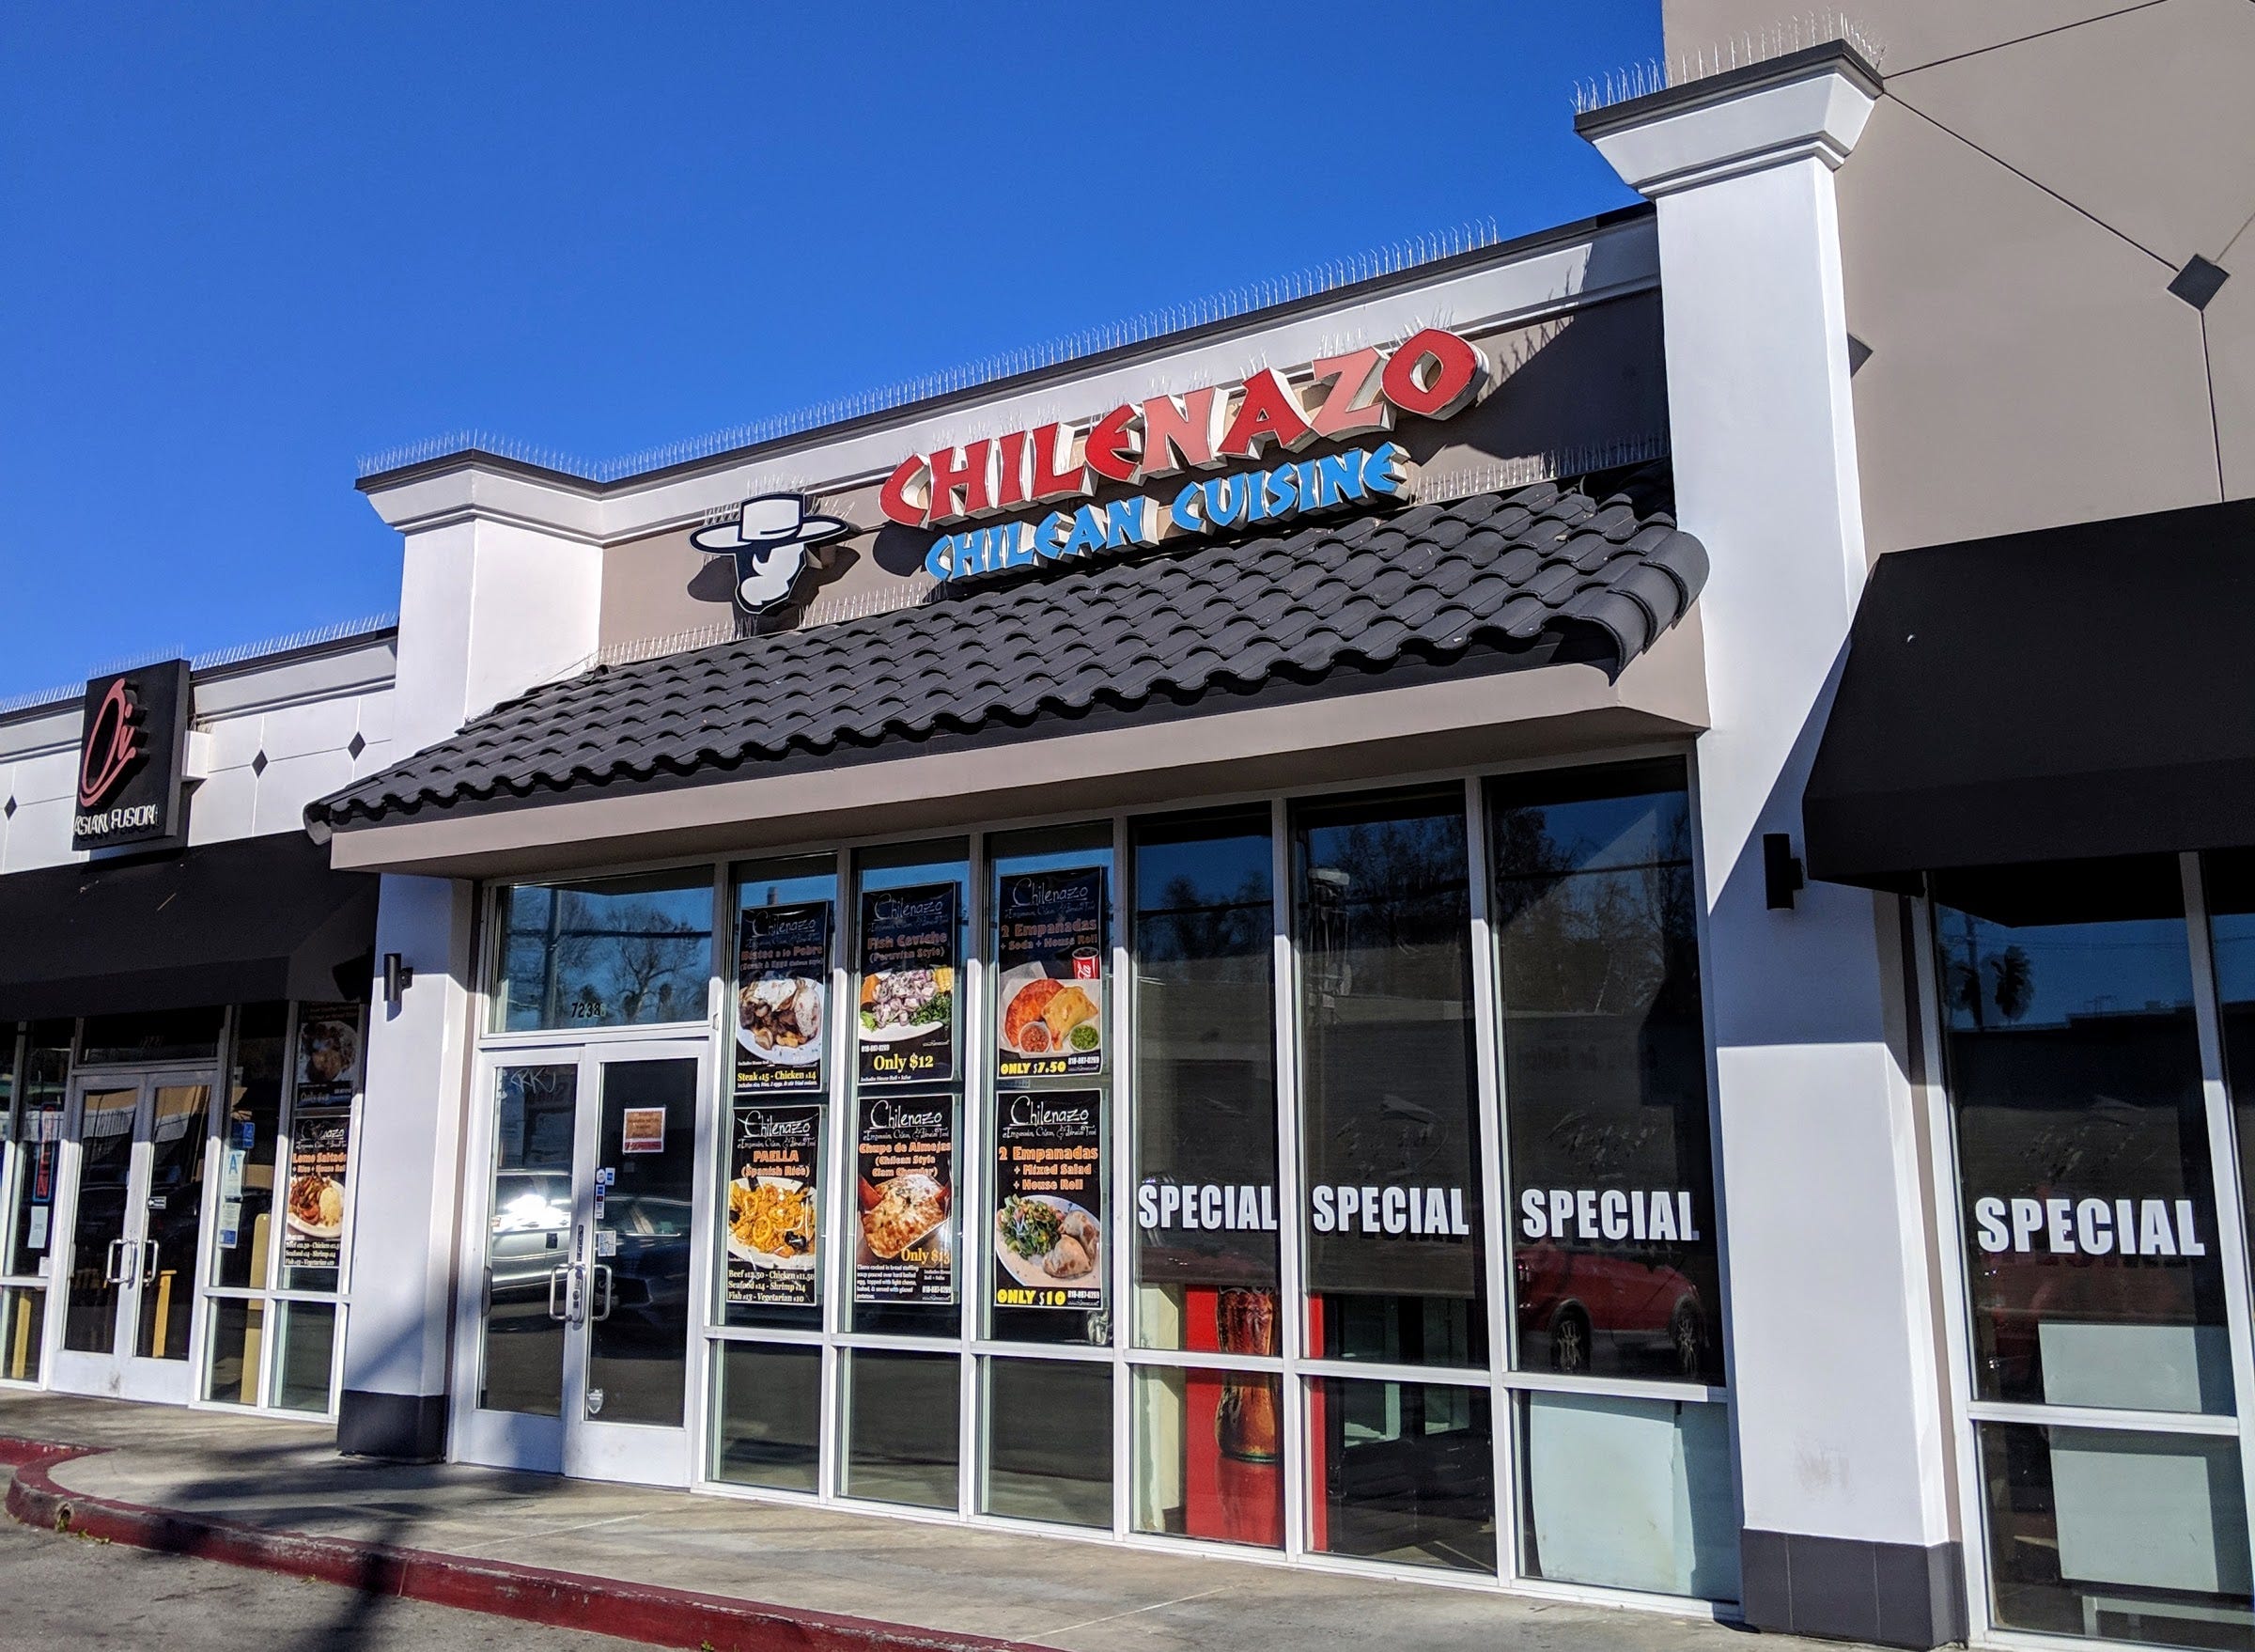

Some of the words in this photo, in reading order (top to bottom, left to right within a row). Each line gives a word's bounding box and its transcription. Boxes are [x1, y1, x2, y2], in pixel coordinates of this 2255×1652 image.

[879, 328, 1486, 528] CHILENAZO
[925, 494, 1152, 582] CHILEAN
[1172, 442, 1411, 535] CUISINE
[74, 813, 109, 835] ASIAN
[111, 803, 156, 830] FUSION
[1010, 877, 1088, 908] Chilenazo
[873, 893, 943, 921] Chilenazo
[751, 910, 816, 938] Chilenazo
[1001, 924, 1009, 938] 2
[1015, 918, 1097, 938] Empanadas
[867, 936, 894, 950] Fish
[896, 930, 948, 947] Ceviche
[1044, 936, 1076, 948] House
[1077, 934, 1098, 945] Roll
[916, 945, 945, 959] Style)
[873, 1053, 907, 1073] Only
[910, 1052, 934, 1070] $12
[1001, 1062, 1031, 1075] ONLY
[1034, 1061, 1066, 1074] $7.50
[738, 1071, 758, 1082] Steak
[774, 1069, 804, 1080] Chicken
[869, 1099, 942, 1130] Chilenazo
[1009, 1095, 1089, 1127] Chilenazo
[744, 1110, 811, 1138] Chilenazo
[754, 1150, 799, 1162] PAELLA
[859, 1143, 892, 1155] Chupe
[894, 1142, 908, 1153] de
[909, 1141, 952, 1153] Almejas
[999, 1145, 1008, 1161] 2
[1013, 1145, 1098, 1162] Empanadas
[228, 1154, 238, 1175] A
[292, 1153, 316, 1163] Lomo
[875, 1155, 911, 1166] (Chilean
[912, 1155, 936, 1165] Style
[741, 1164, 783, 1178] (Spanish
[784, 1164, 811, 1177] Rice)
[872, 1167, 894, 1177] Clam
[1014, 1165, 1020, 1175] +
[1022, 1163, 1058, 1176] Mixed
[1060, 1163, 1092, 1176] Salad
[1013, 1180, 1019, 1190] +
[1022, 1178, 1058, 1191] House
[1060, 1178, 1083, 1191] Roll
[1138, 1184, 1277, 1230] SPECIAL
[1313, 1185, 1470, 1235] SPECIAL
[1521, 1188, 1699, 1241] SPECIAL
[1975, 1196, 2205, 1256] SPECIAL
[901, 1247, 929, 1265] Only
[931, 1247, 950, 1265] $13
[728, 1270, 744, 1278] Beef
[769, 1270, 796, 1280] Chicken
[728, 1280, 754, 1289] Seafood
[770, 1281, 795, 1292] Shrimp
[728, 1291, 742, 1300] Fish
[756, 1292, 793, 1302] Vegetarian
[997, 1288, 1036, 1304] ONLY
[1039, 1290, 1065, 1306] $10
